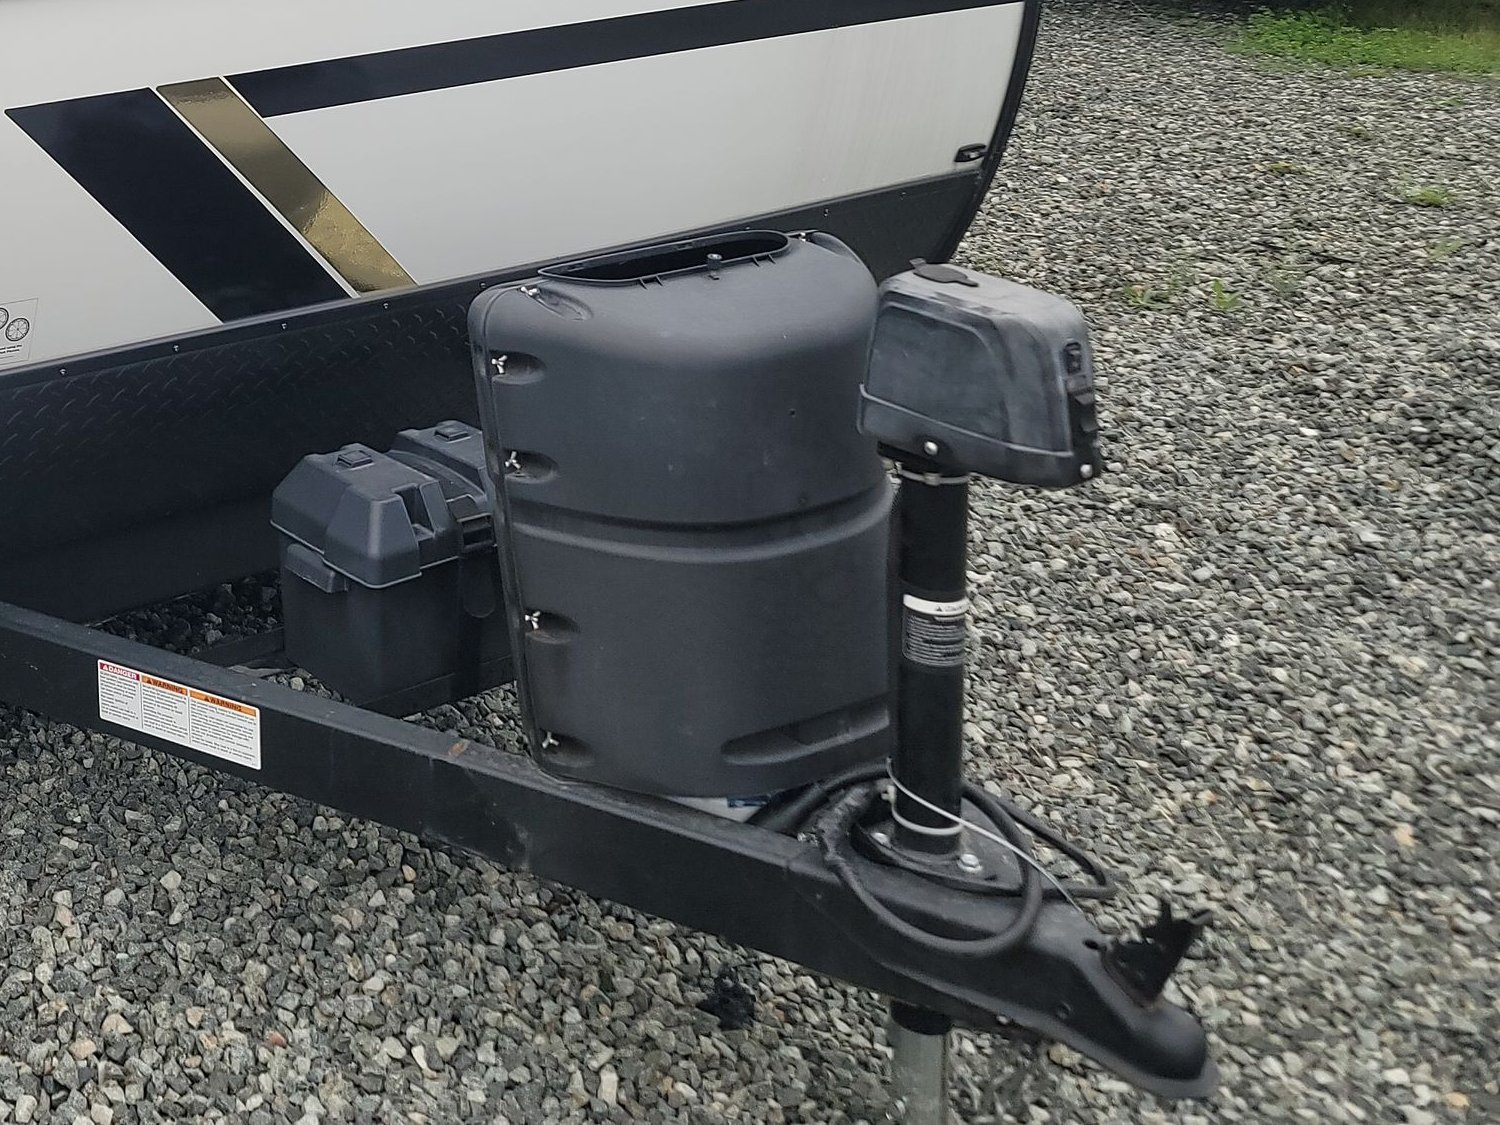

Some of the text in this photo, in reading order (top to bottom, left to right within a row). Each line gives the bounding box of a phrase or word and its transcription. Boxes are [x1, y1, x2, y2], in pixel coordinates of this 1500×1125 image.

[108, 666, 138, 681] DANGER
[152, 679, 183, 694] WARNING
[209, 697, 242, 712] WARNING
